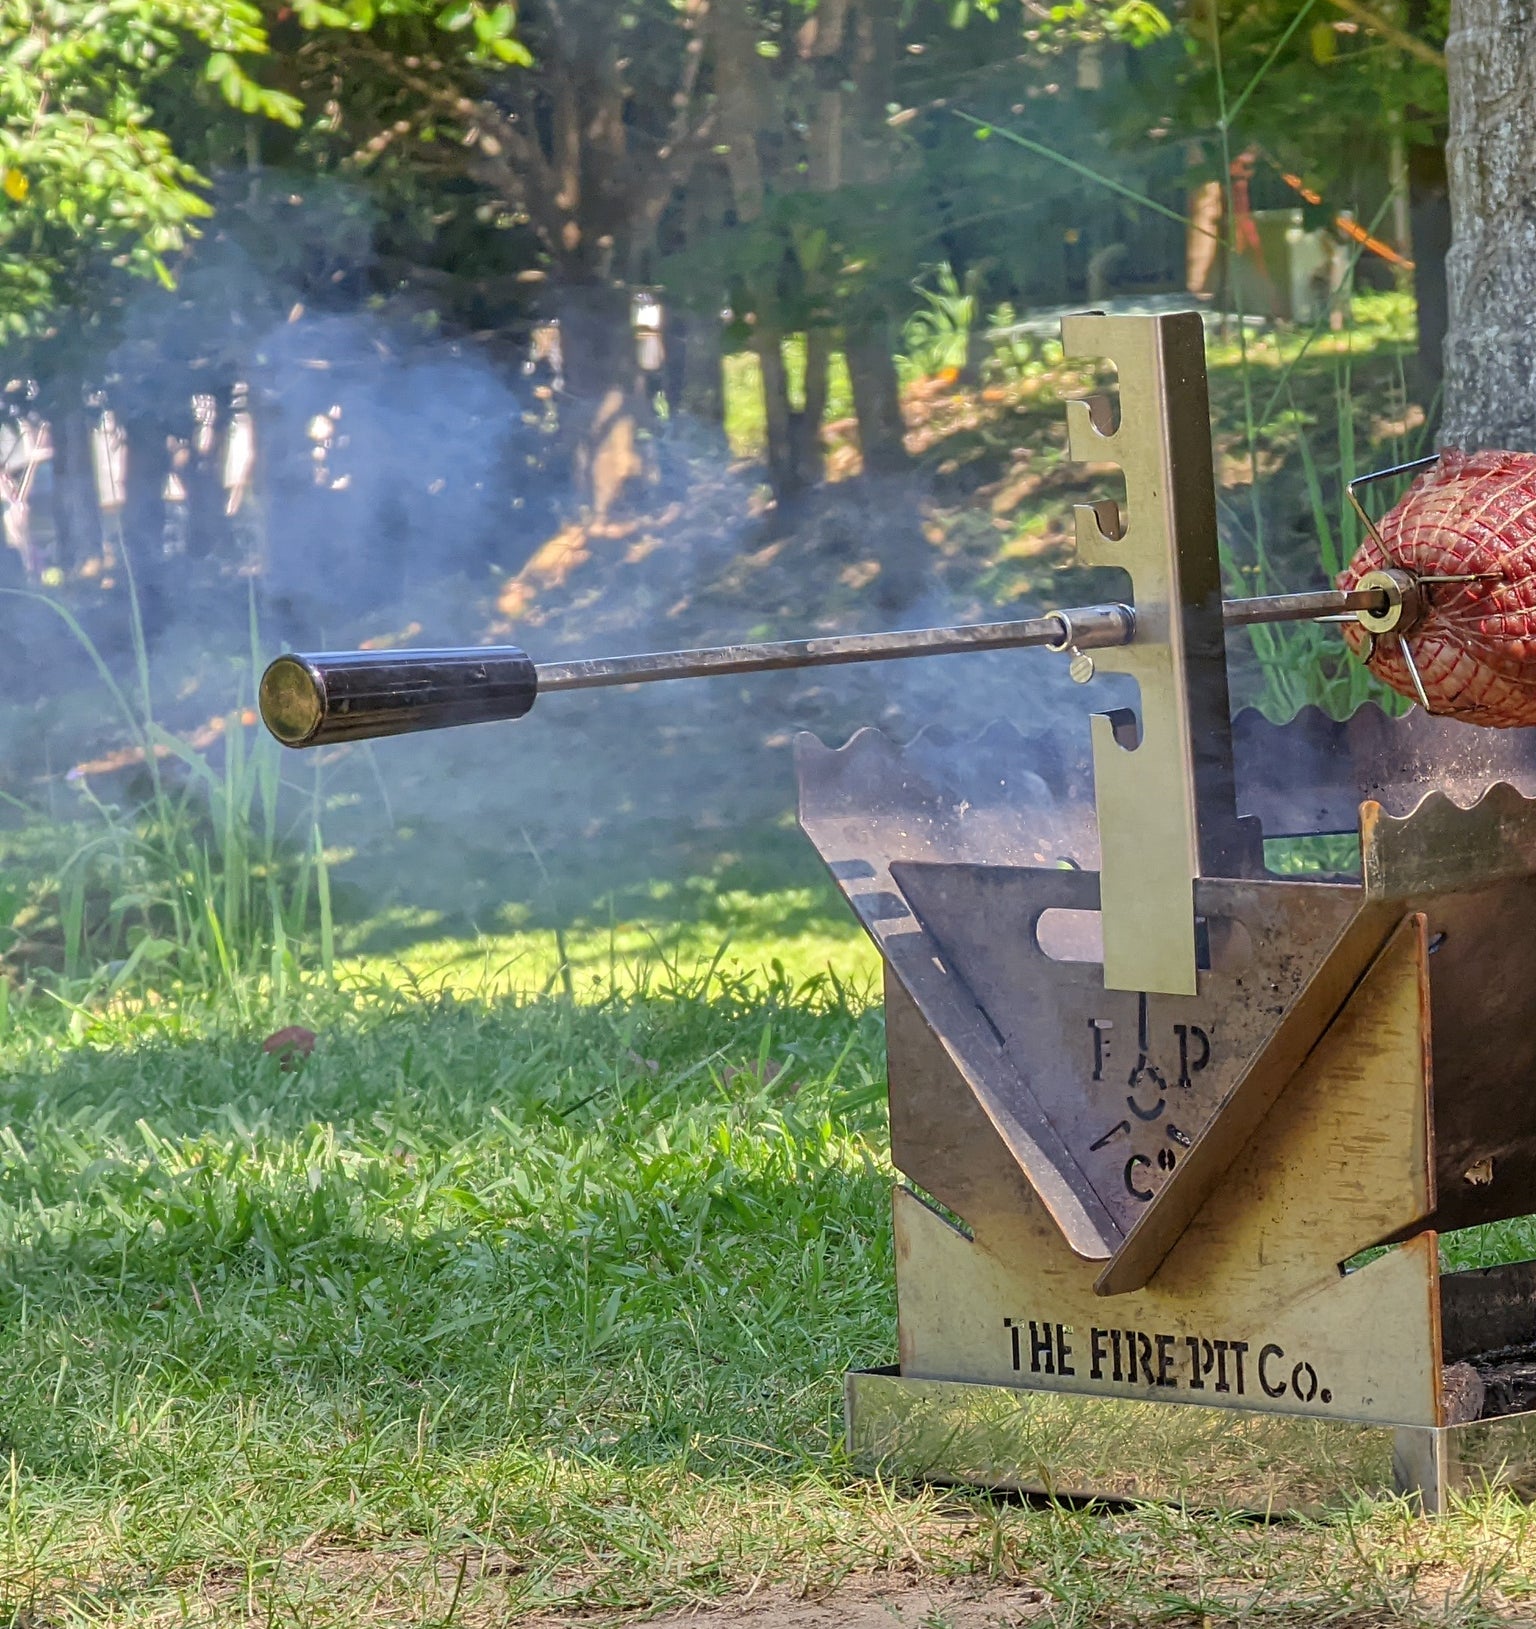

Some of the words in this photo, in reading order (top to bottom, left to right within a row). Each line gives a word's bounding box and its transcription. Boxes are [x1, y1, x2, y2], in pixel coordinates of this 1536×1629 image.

[1003, 1317, 1075, 1376] THE
[1089, 1327, 1178, 1388] FIRE
[1185, 1335, 1249, 1395] PIT
[1257, 1342, 1334, 1404] Co.
